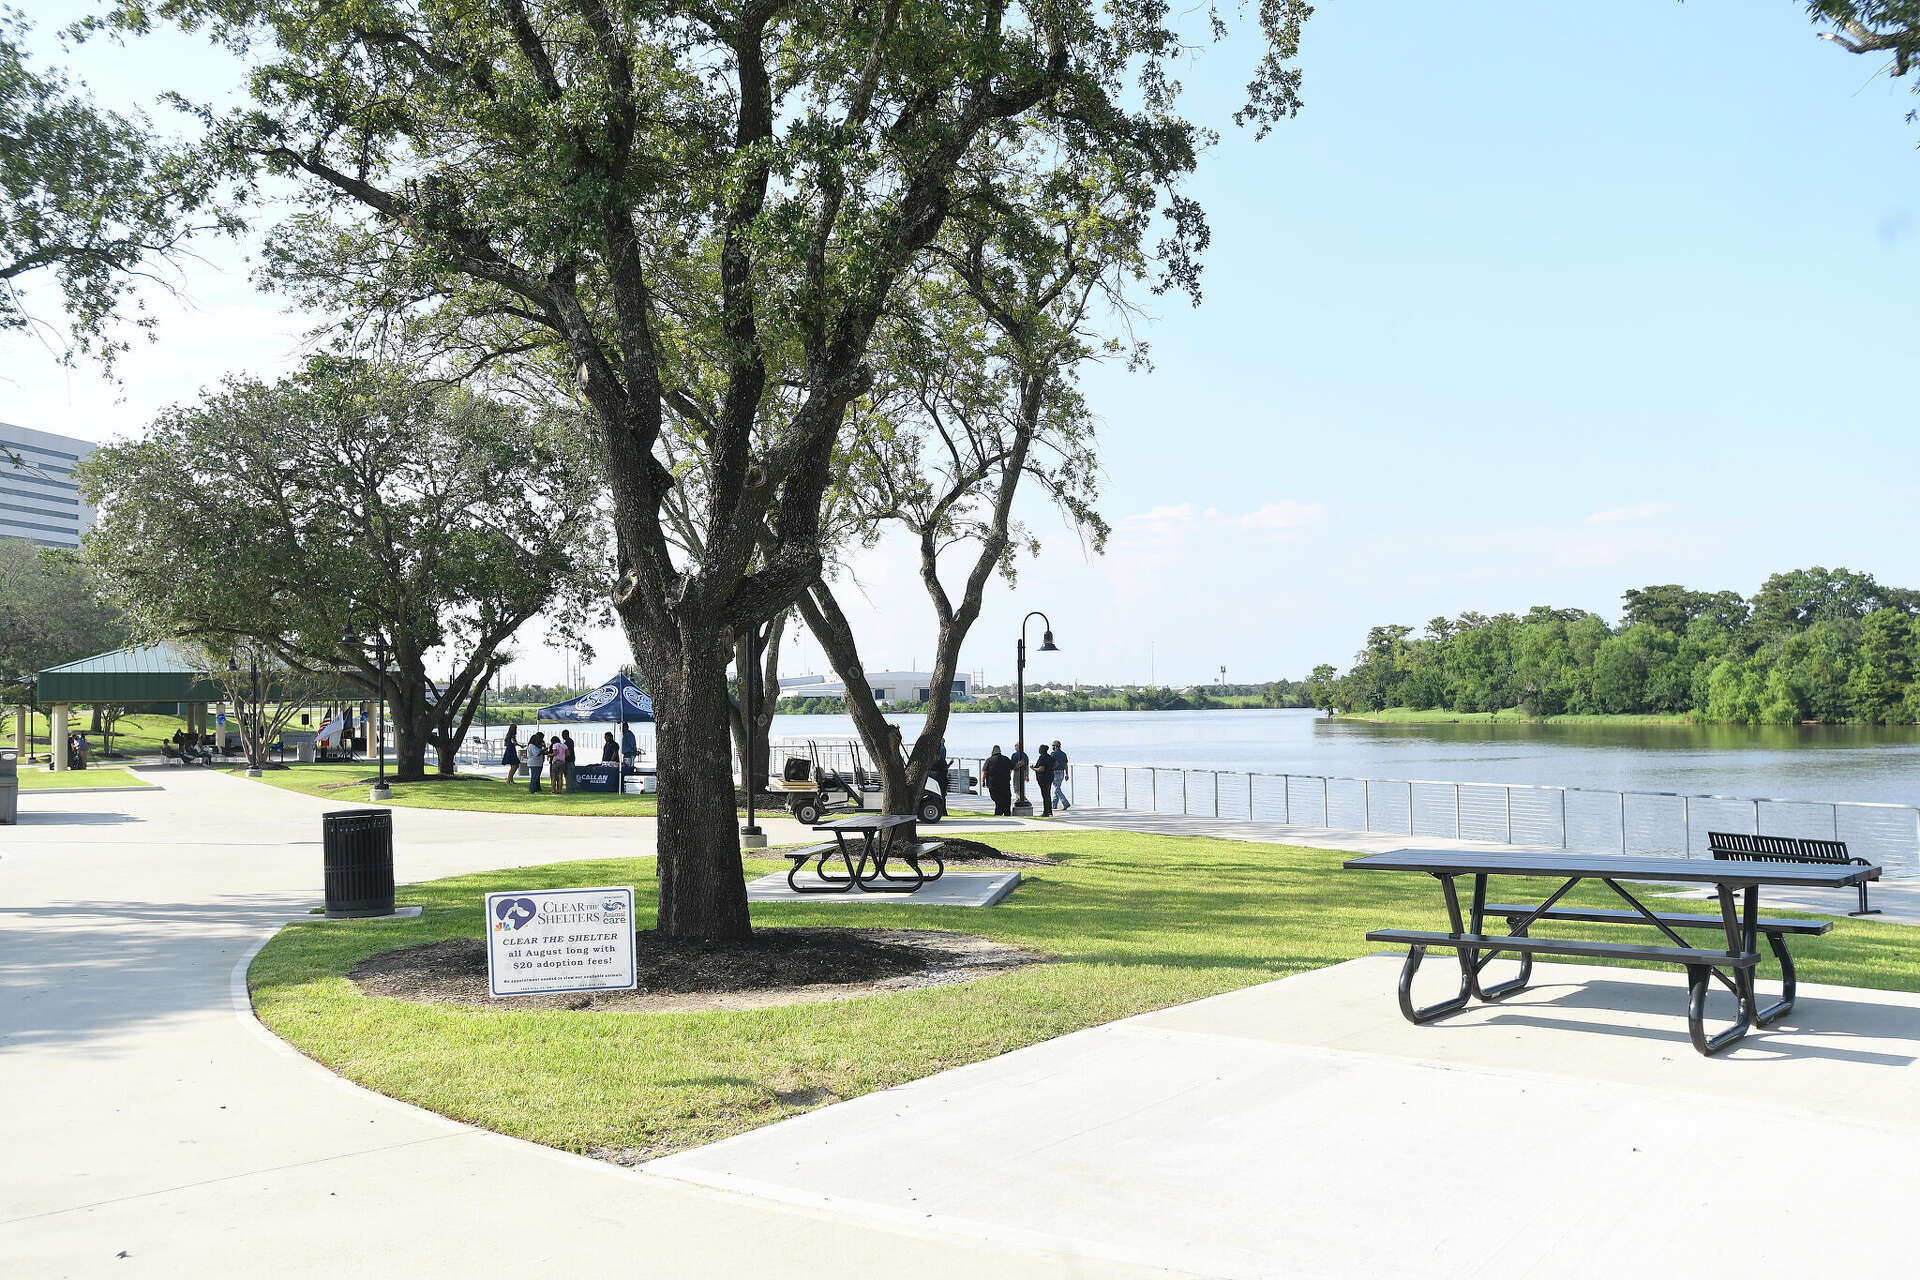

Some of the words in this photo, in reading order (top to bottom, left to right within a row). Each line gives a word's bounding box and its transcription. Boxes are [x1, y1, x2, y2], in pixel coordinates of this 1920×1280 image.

[543, 901, 585, 913] CLEAR
[537, 912, 600, 925] SHELTERS
[502, 937, 538, 946] CLEAR
[542, 936, 564, 944] THE
[568, 933, 618, 943] SHELTER
[508, 950, 521, 958] all
[525, 948, 562, 957] August
[566, 947, 589, 955] long
[592, 945, 616, 953] with
[513, 962, 533, 970] $20
[536, 959, 583, 968] adoption
[587, 957, 612, 965] fees!
